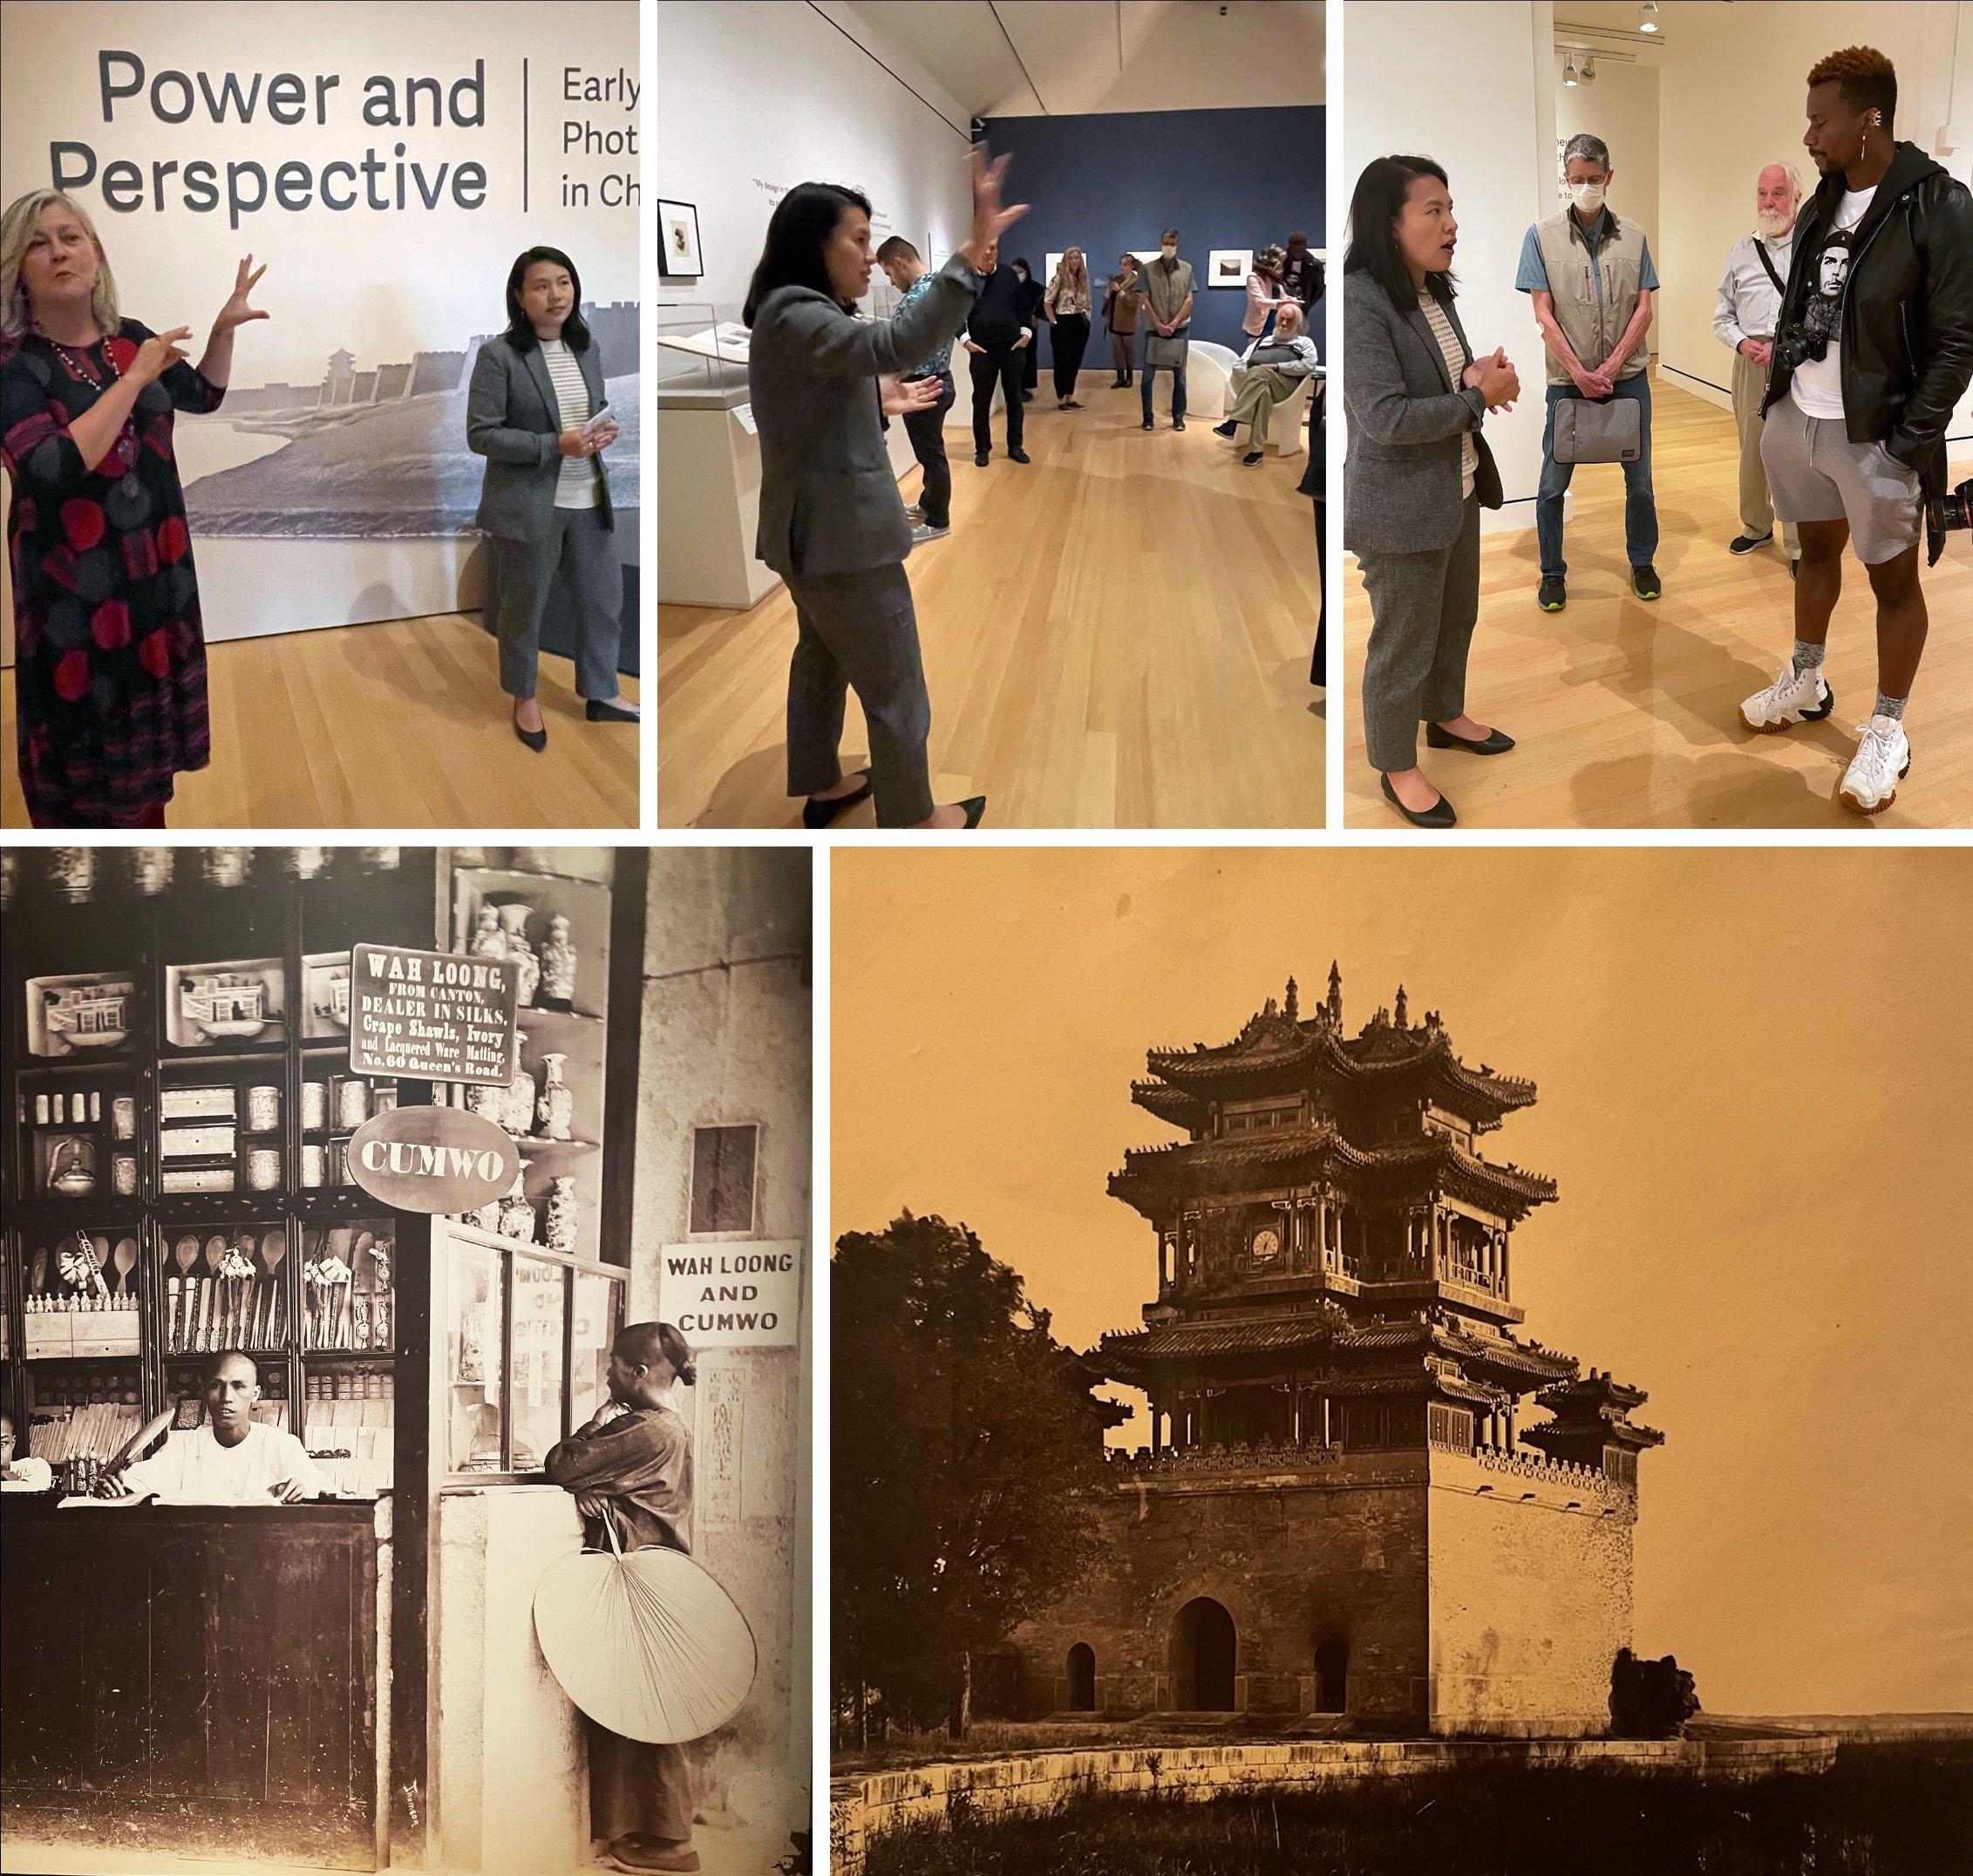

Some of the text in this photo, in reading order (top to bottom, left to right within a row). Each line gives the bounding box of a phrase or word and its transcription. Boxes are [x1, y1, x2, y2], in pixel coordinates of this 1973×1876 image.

[99, 50, 486, 127] Power and
[564, 67, 640, 112] Early
[50, 141, 487, 229] Perspective
[562, 173, 588, 207] in
[367, 953, 507, 994] WAH LOONG,
[362, 996, 426, 1017] DEALER
[434, 1003, 451, 1020] IN
[389, 982, 485, 1005] FROM CANTON,
[409, 1019, 460, 1043] Shawls,
[466, 1024, 505, 1049] Ivory
[361, 1036, 506, 1065] and Lacquered Ware Matting,
[408, 1057, 461, 1073] Queen's
[465, 1062, 503, 1077] Road.
[361, 1140, 504, 1182] CUMWO
[667, 1254, 793, 1276] WAH LOONG
[700, 1286, 758, 1302] AND
[678, 1312, 778, 1331] CUMWO
